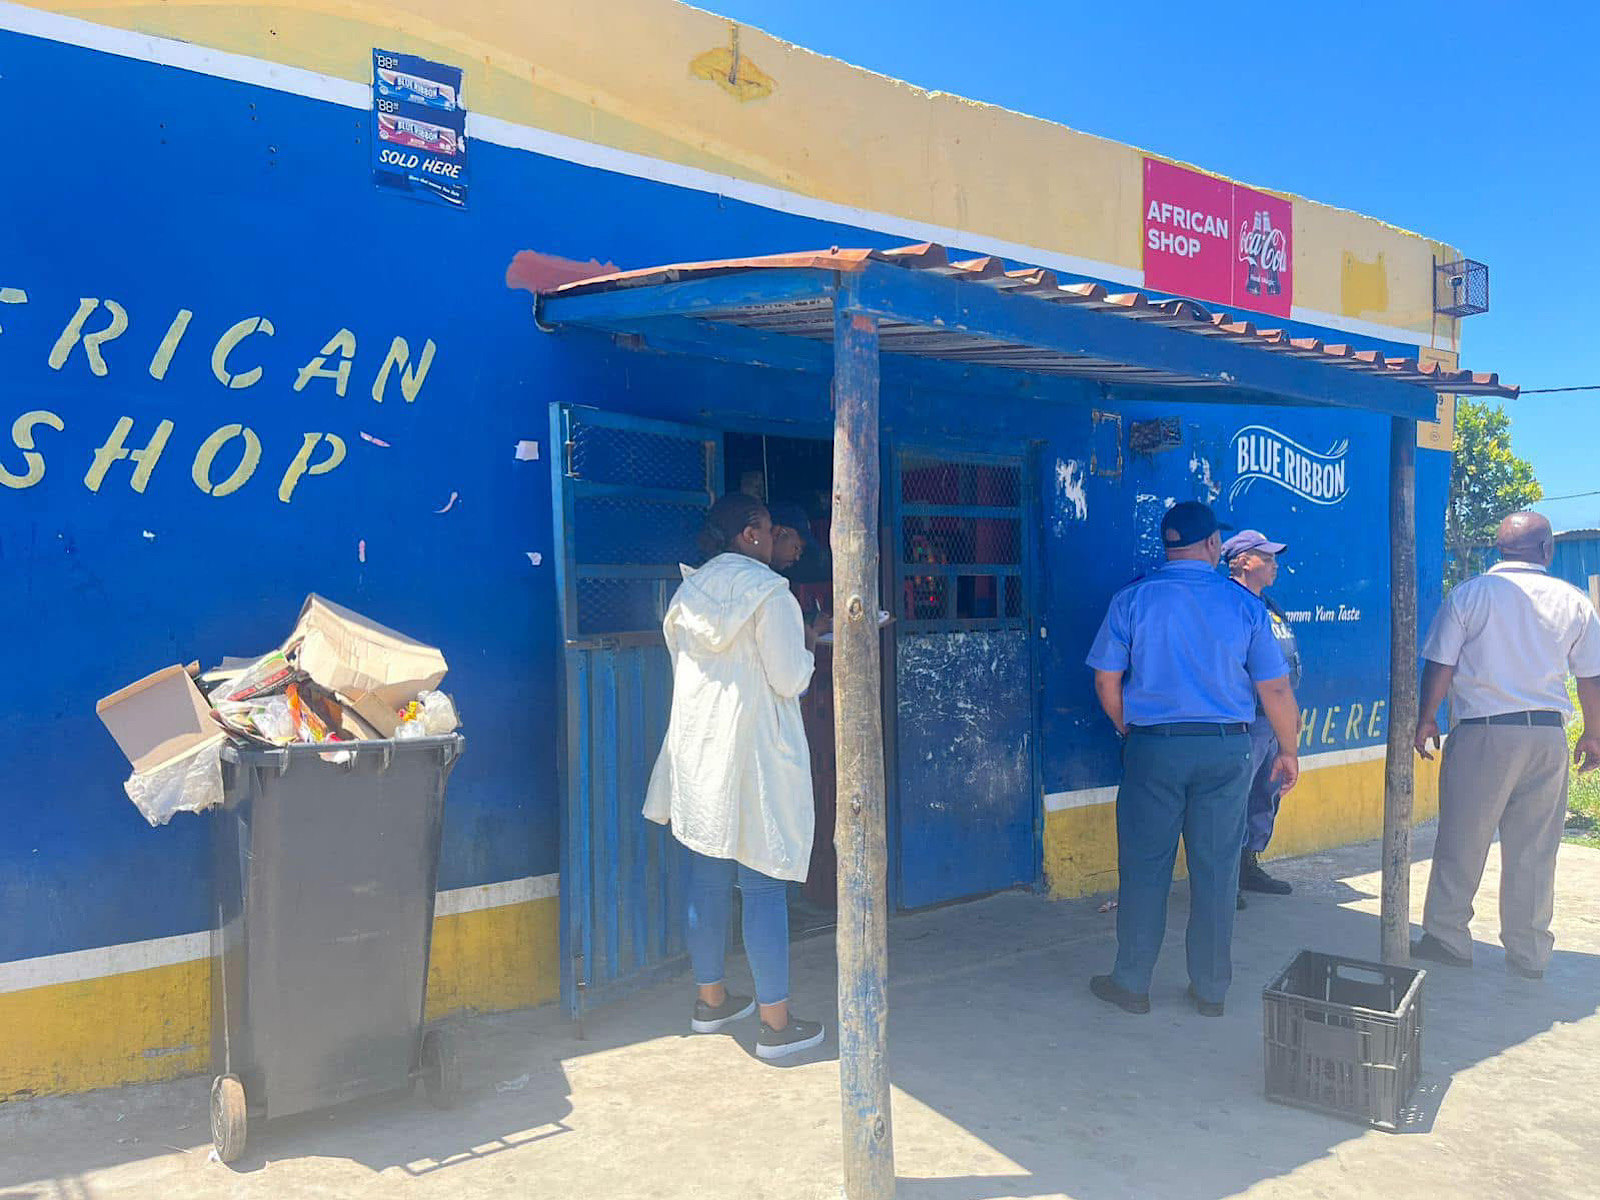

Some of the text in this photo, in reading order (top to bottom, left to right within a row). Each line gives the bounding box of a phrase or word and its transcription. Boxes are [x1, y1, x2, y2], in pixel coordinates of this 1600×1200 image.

[379, 149, 462, 179] SOLD HERE
[1147, 199, 1229, 240] AFRICAN
[1148, 228, 1201, 258] SHOP
[0, 287, 436, 402] RICAN
[0, 410, 347, 503] SHOP
[1237, 434, 1345, 499] BLUE RIBBON
[1315, 604, 1335, 623] Yum
[1338, 604, 1361, 622] Taste
[1297, 699, 1386, 748] HERE
